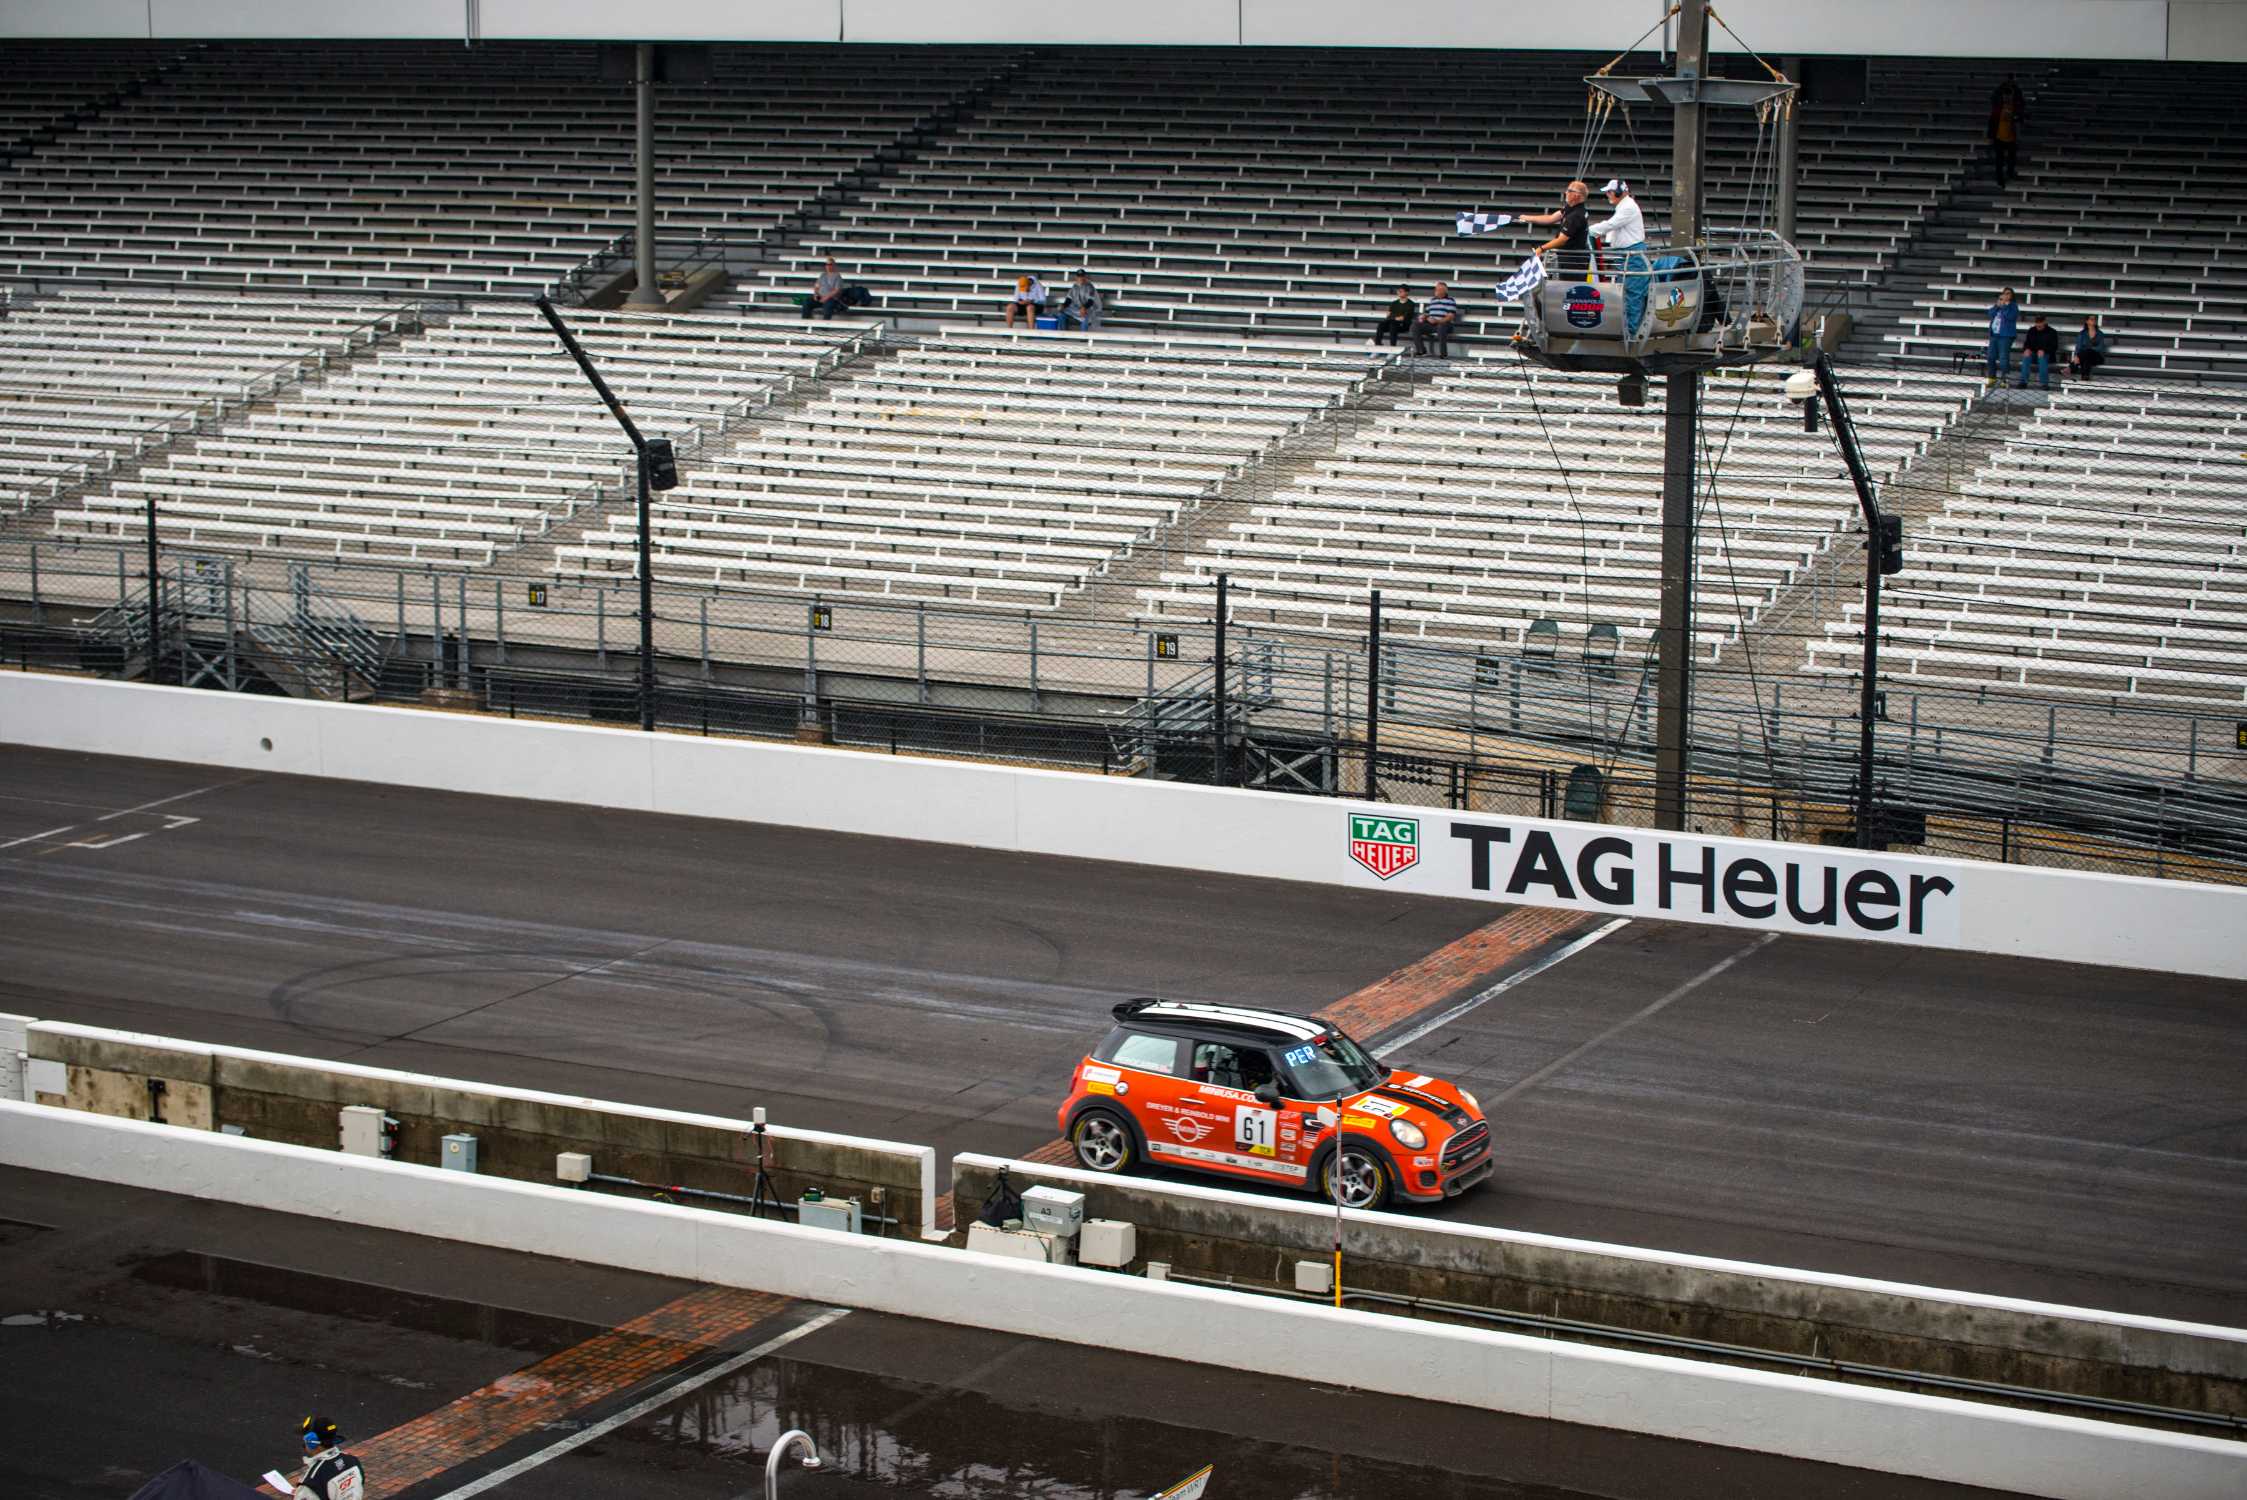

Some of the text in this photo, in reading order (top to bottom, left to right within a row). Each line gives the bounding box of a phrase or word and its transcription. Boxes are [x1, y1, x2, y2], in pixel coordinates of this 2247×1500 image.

[1571, 303, 1605, 312] HOUR
[536, 591, 545, 604] 17
[820, 614, 830, 627] 18
[1166, 642, 1176, 656] 19
[1355, 819, 1412, 842] TAG
[1354, 842, 1414, 874] HEUER
[1450, 823, 1955, 934] TAG Heuer
[1284, 1045, 1317, 1067] PER
[1145, 1102, 1174, 1113] DREYER
[1243, 1116, 1266, 1145] 61
[1041, 1207, 1052, 1216] A3
